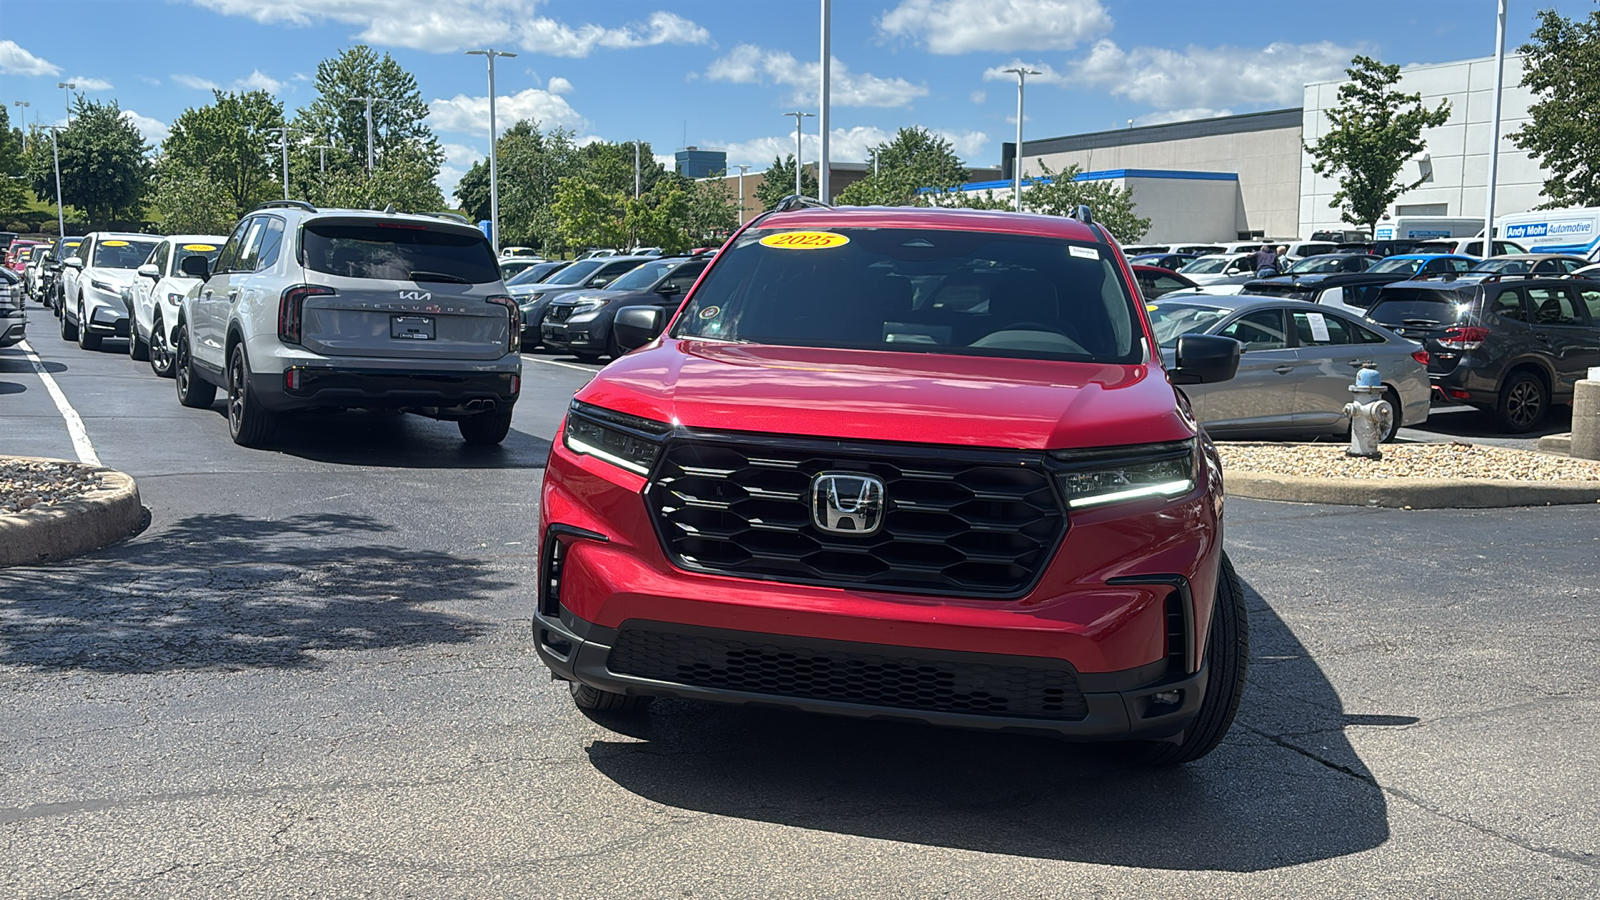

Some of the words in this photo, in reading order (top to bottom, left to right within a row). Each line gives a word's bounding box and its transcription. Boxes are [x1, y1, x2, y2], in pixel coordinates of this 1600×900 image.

[1507, 226, 1526, 238] Andy
[1527, 225, 1546, 236] Mohr
[1548, 222, 1591, 234] Automotive
[772, 235, 837, 246] 2025
[399, 290, 432, 301] KIA
[361, 302, 466, 313] TELLURIDE
